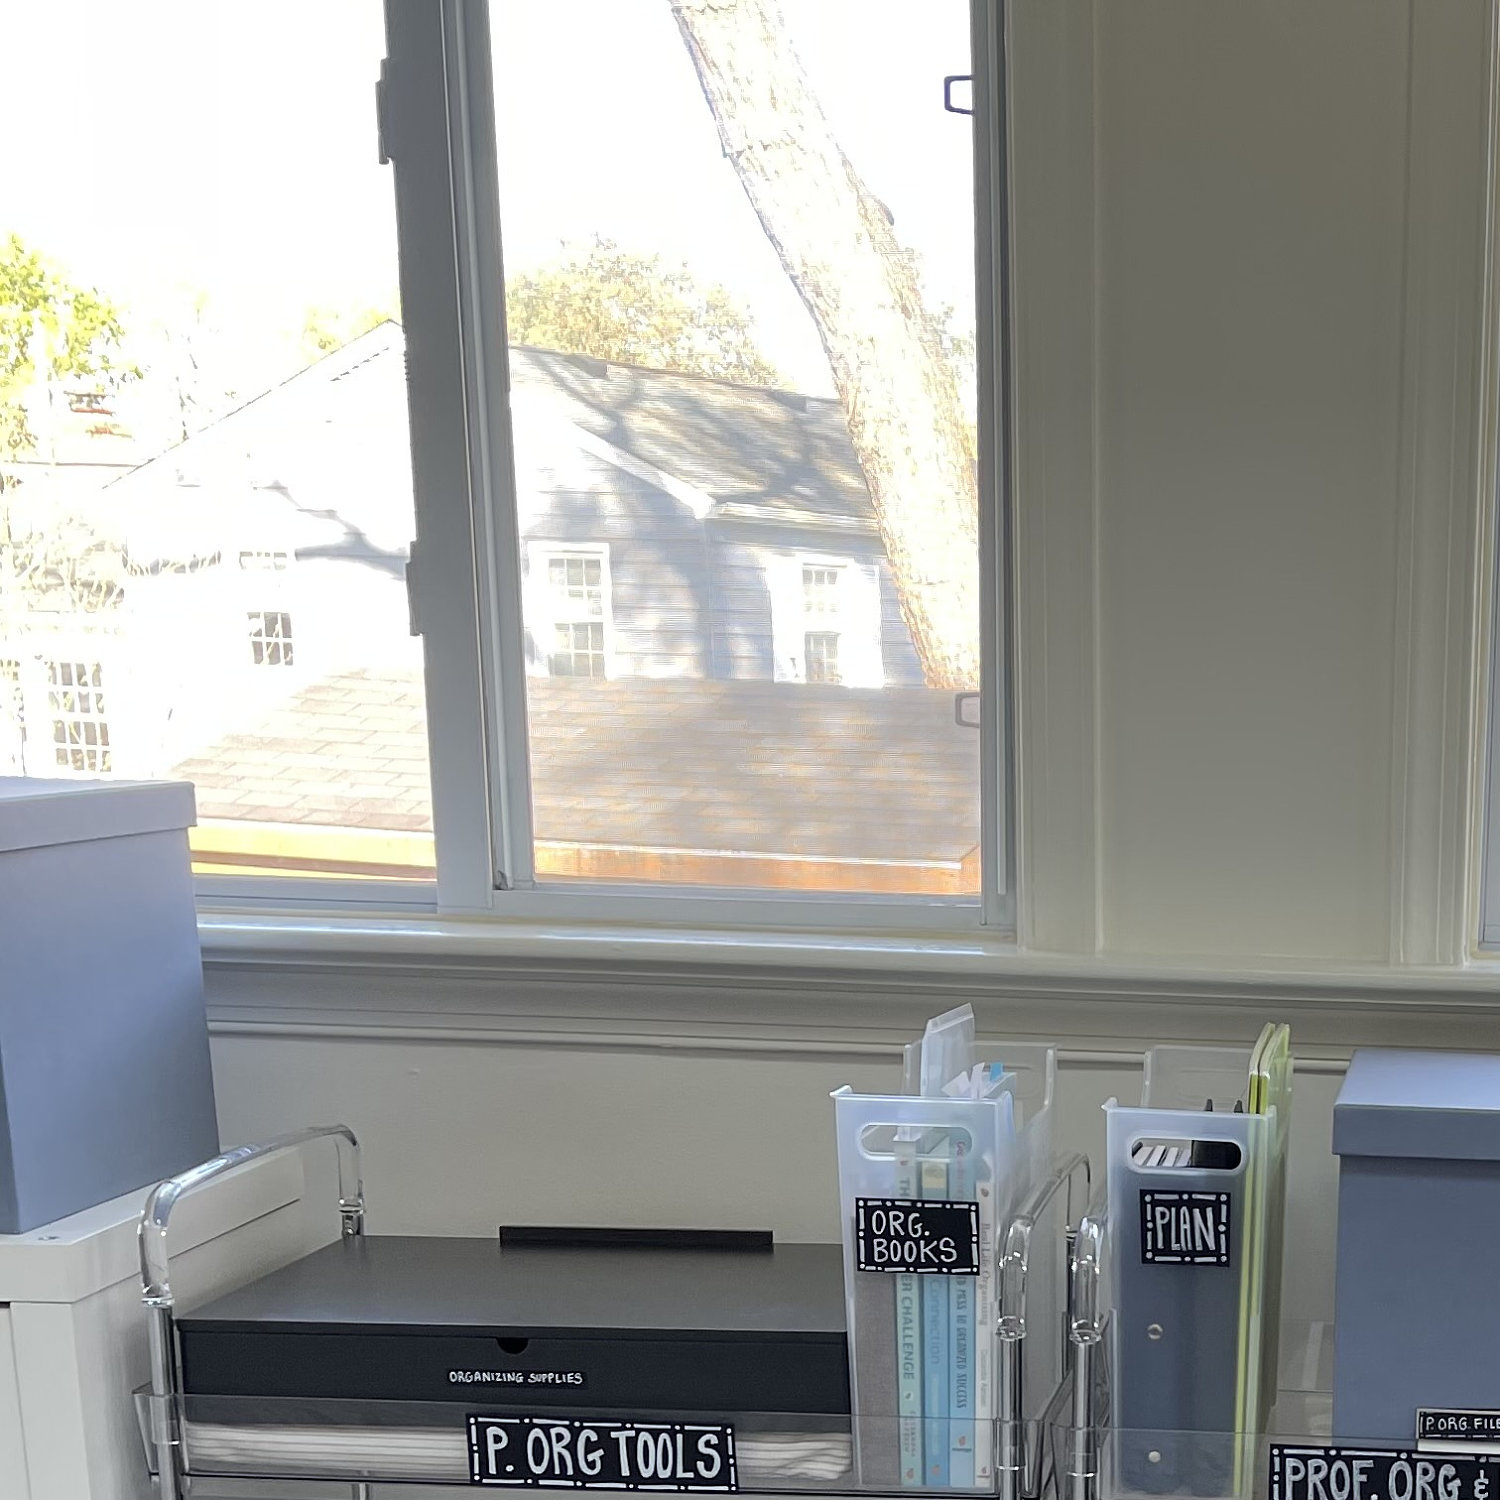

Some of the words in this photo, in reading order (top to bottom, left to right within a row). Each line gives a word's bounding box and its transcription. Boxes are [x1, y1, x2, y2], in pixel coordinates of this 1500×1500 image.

[871, 1210, 930, 1238] ORG.
[1155, 1206, 1216, 1251] PLAN
[873, 1237, 958, 1263] BOOKS
[901, 1297, 915, 1380] CHALLENGE
[930, 1280, 942, 1365] Connection
[449, 1371, 524, 1384] ORGANIZING
[527, 1372, 583, 1385] SUPPLIES
[956, 1373, 967, 1408] SUCCESS
[486, 1426, 515, 1474] P.
[526, 1426, 604, 1475] ORG
[610, 1430, 722, 1479] TOOLS
